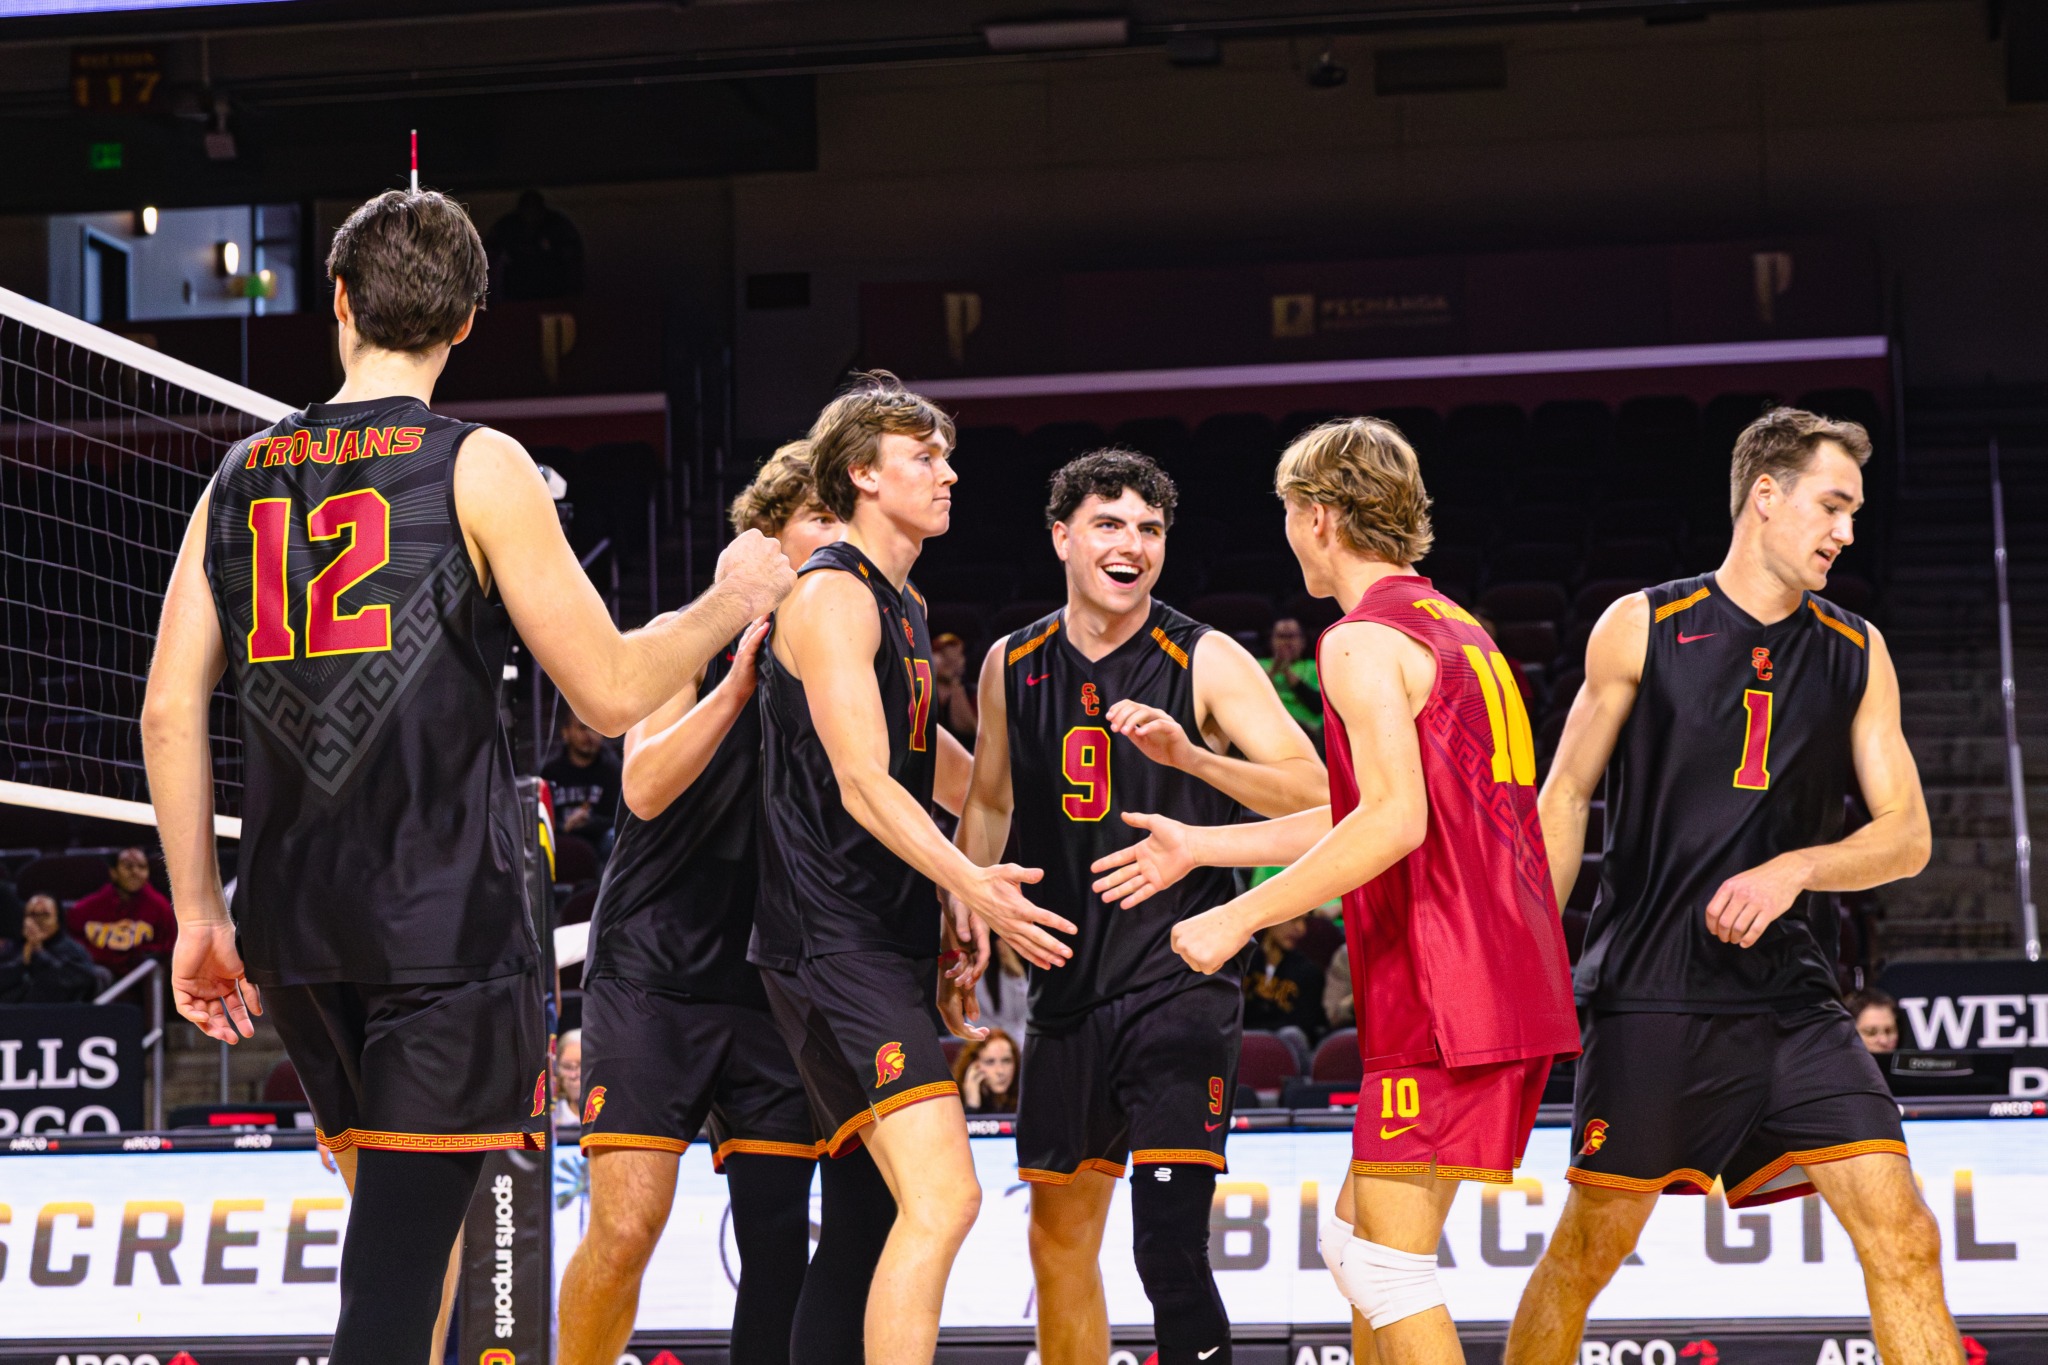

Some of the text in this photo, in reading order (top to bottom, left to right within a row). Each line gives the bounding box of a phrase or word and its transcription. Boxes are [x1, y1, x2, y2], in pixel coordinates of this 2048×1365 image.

[245, 426, 426, 470] TROJANS
[248, 487, 392, 664] 12
[1062, 726, 1111, 822] 9
[1732, 688, 1773, 791] 1
[1208, 1076, 1225, 1116] 9
[1381, 1077, 1421, 1119] 10
[491, 1174, 515, 1248] sports
[1704, 1169, 2018, 1265] GIL
[491, 1249, 515, 1339] imports
